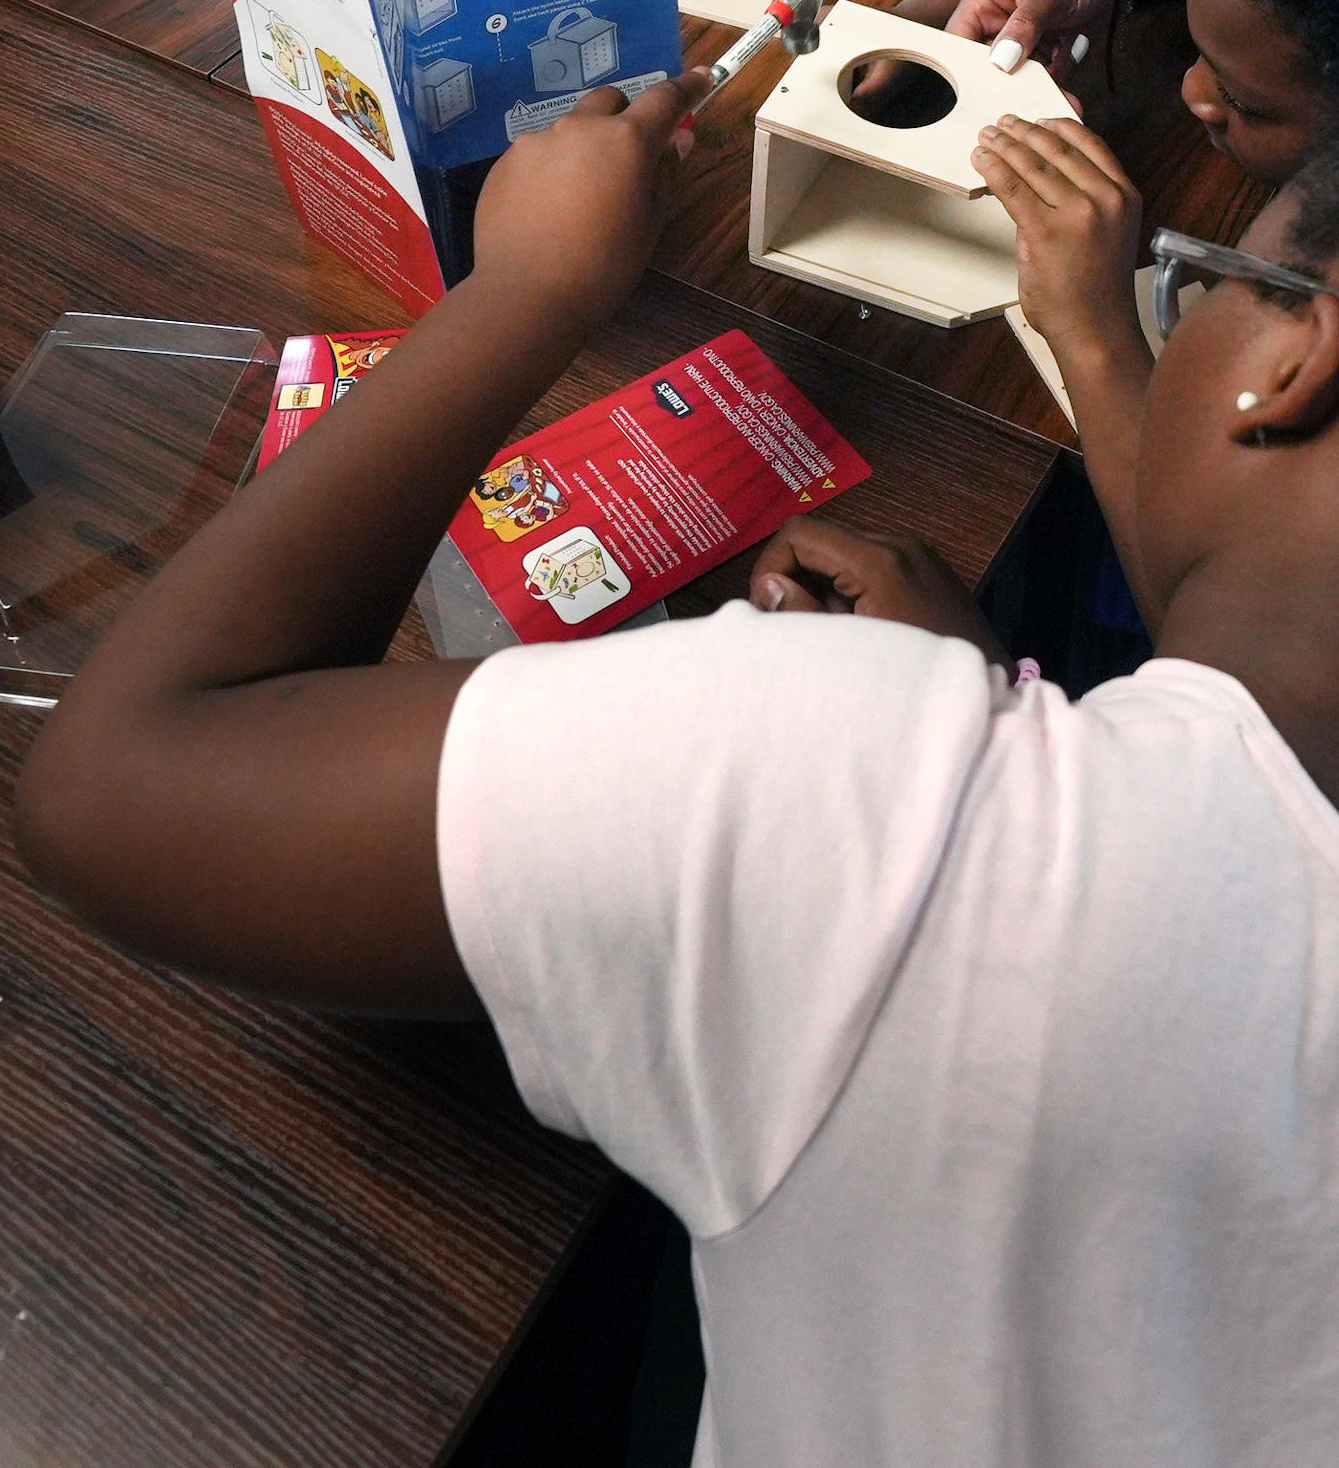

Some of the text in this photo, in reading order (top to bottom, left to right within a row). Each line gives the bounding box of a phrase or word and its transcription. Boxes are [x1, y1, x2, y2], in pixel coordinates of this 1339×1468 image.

[491, 15, 502, 32] 6
[529, 95, 578, 113] WARNING
[655, 378, 689, 417] LOWE'S
